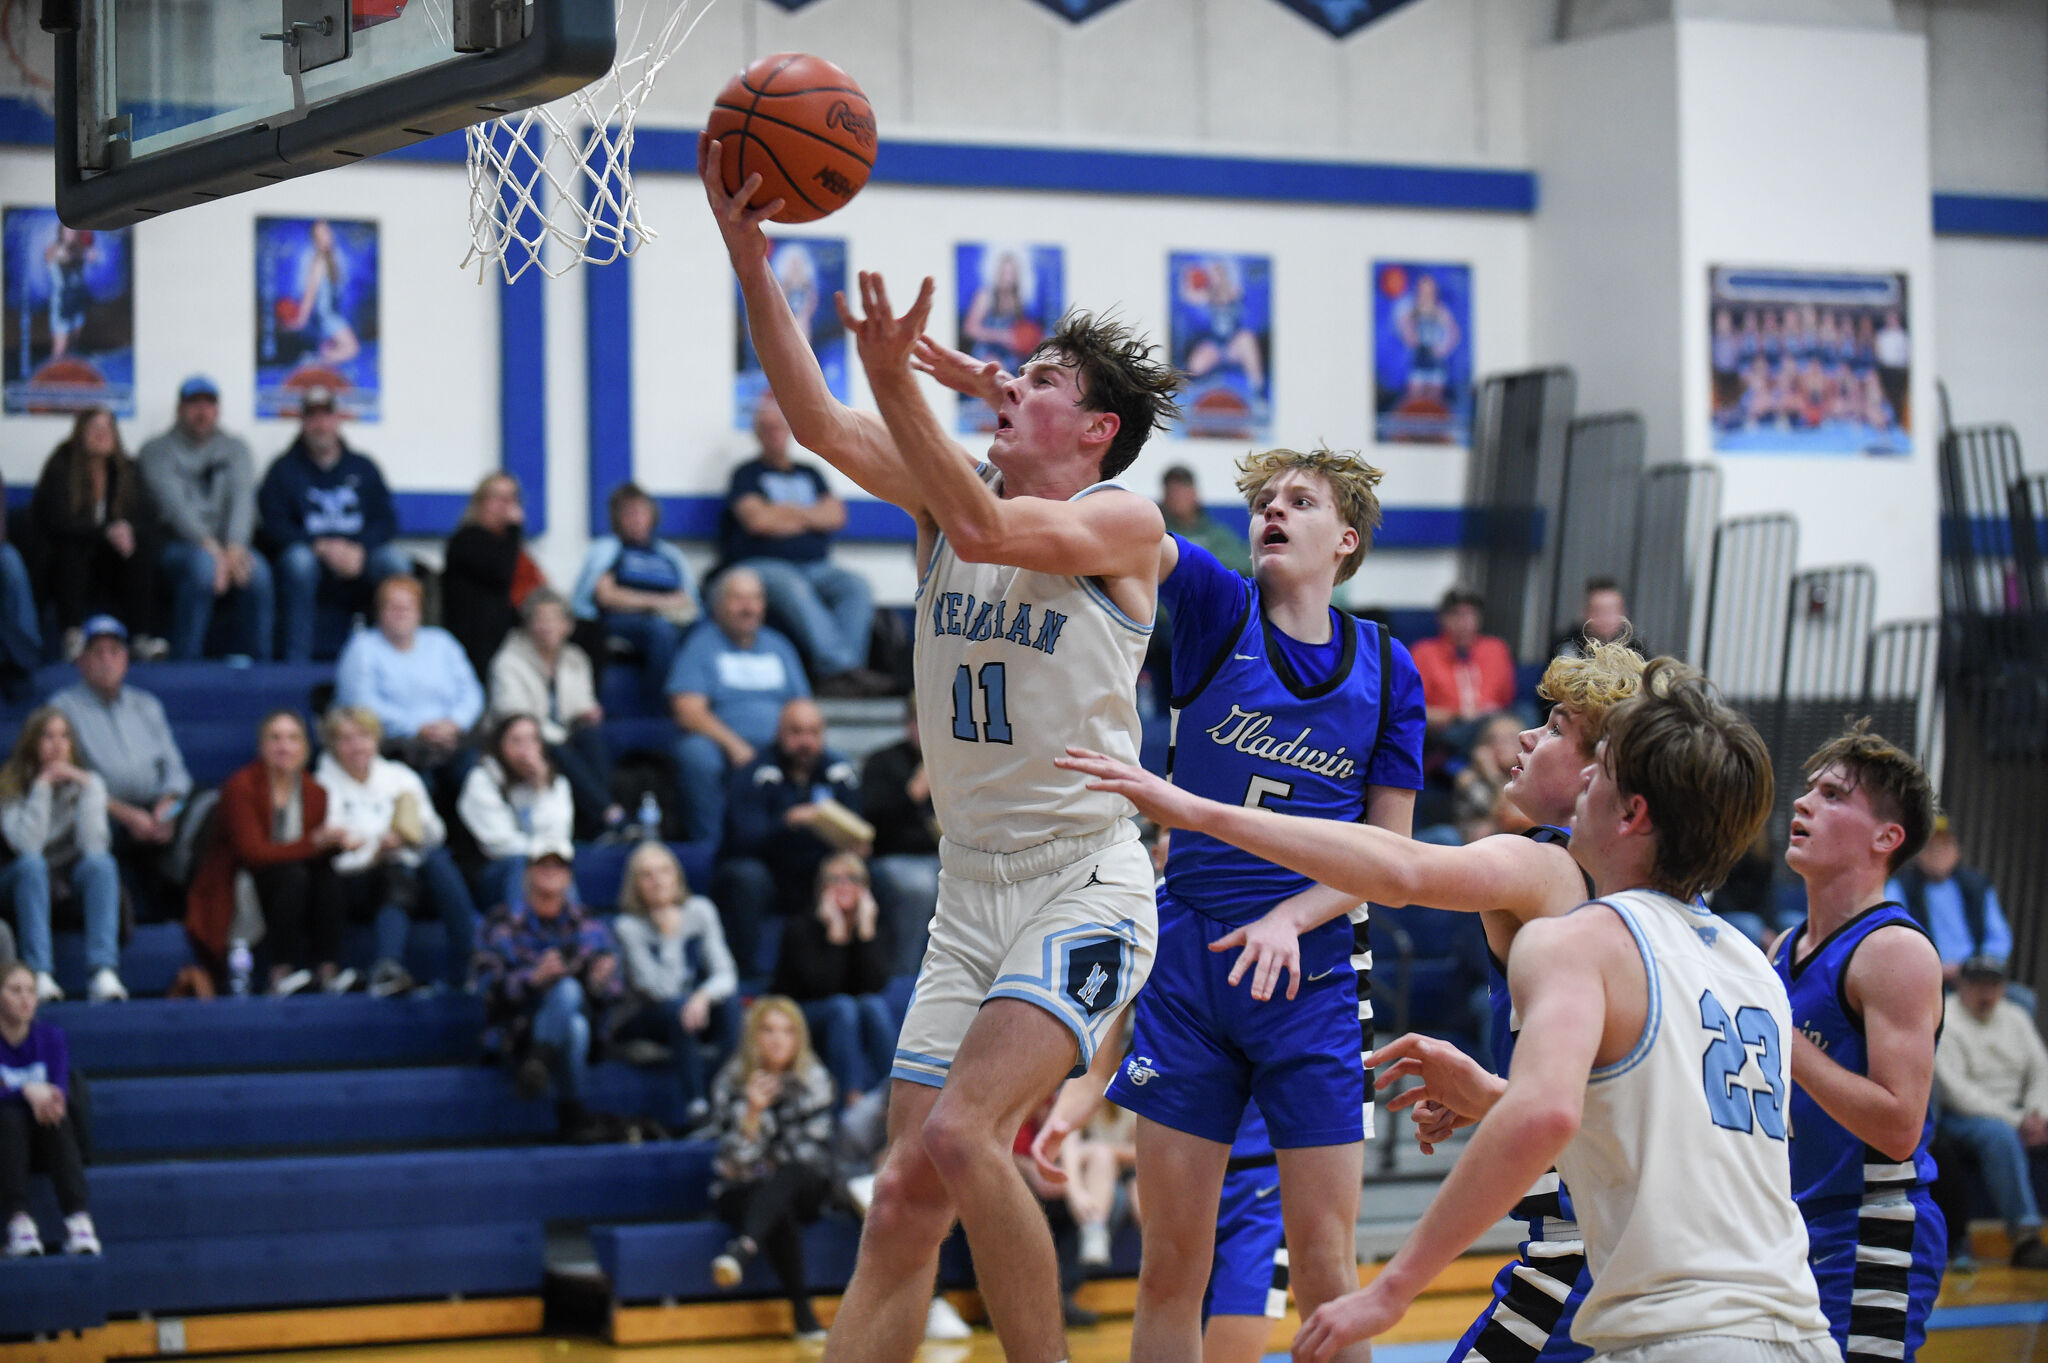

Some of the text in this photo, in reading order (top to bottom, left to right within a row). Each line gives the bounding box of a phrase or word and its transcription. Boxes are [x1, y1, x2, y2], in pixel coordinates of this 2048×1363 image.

[952, 661, 1013, 745] 11
[1206, 704, 1355, 779] Gladwin
[1077, 962, 1109, 1007] M
[1699, 988, 1787, 1141] 23
